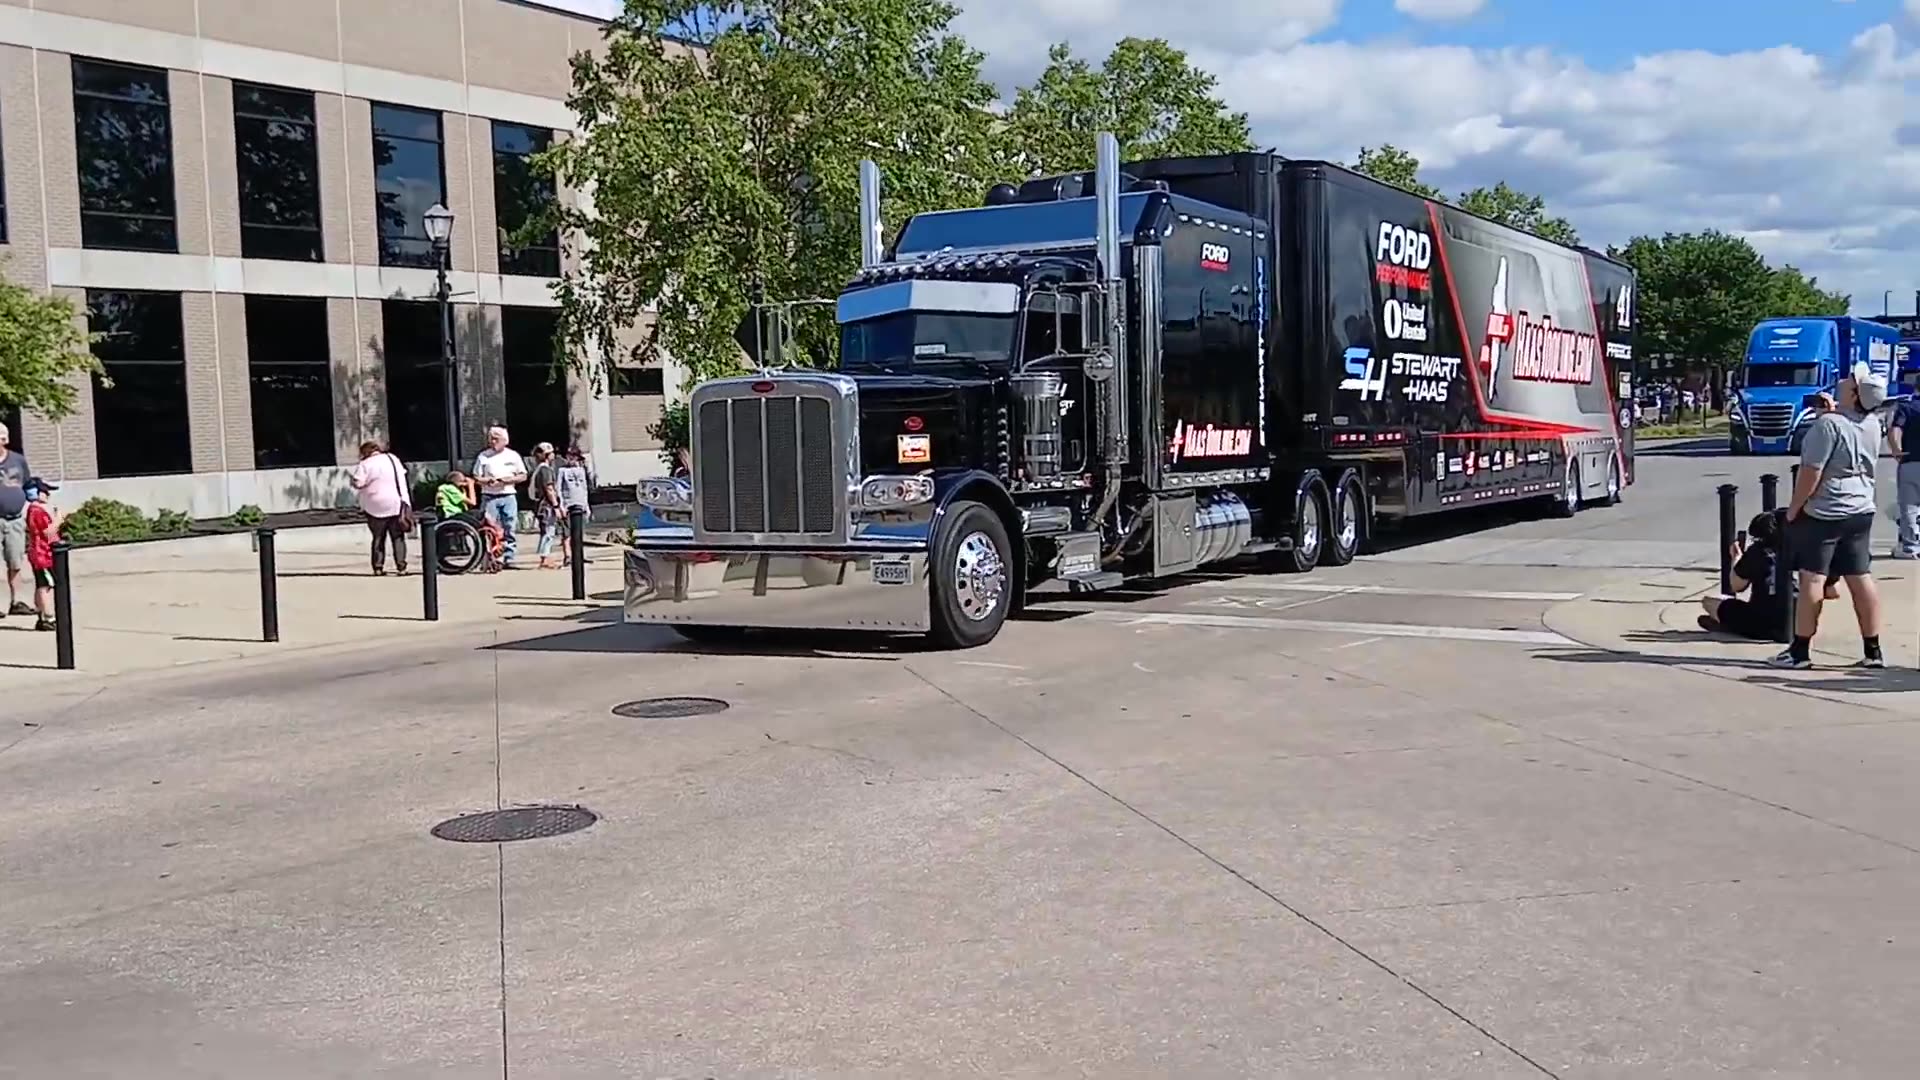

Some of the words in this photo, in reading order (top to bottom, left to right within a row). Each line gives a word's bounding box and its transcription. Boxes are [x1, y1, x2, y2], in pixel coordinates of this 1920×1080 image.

[1202, 243, 1229, 263] FORD
[1377, 222, 1431, 270] FORD
[1392, 353, 1461, 381] STEWART
